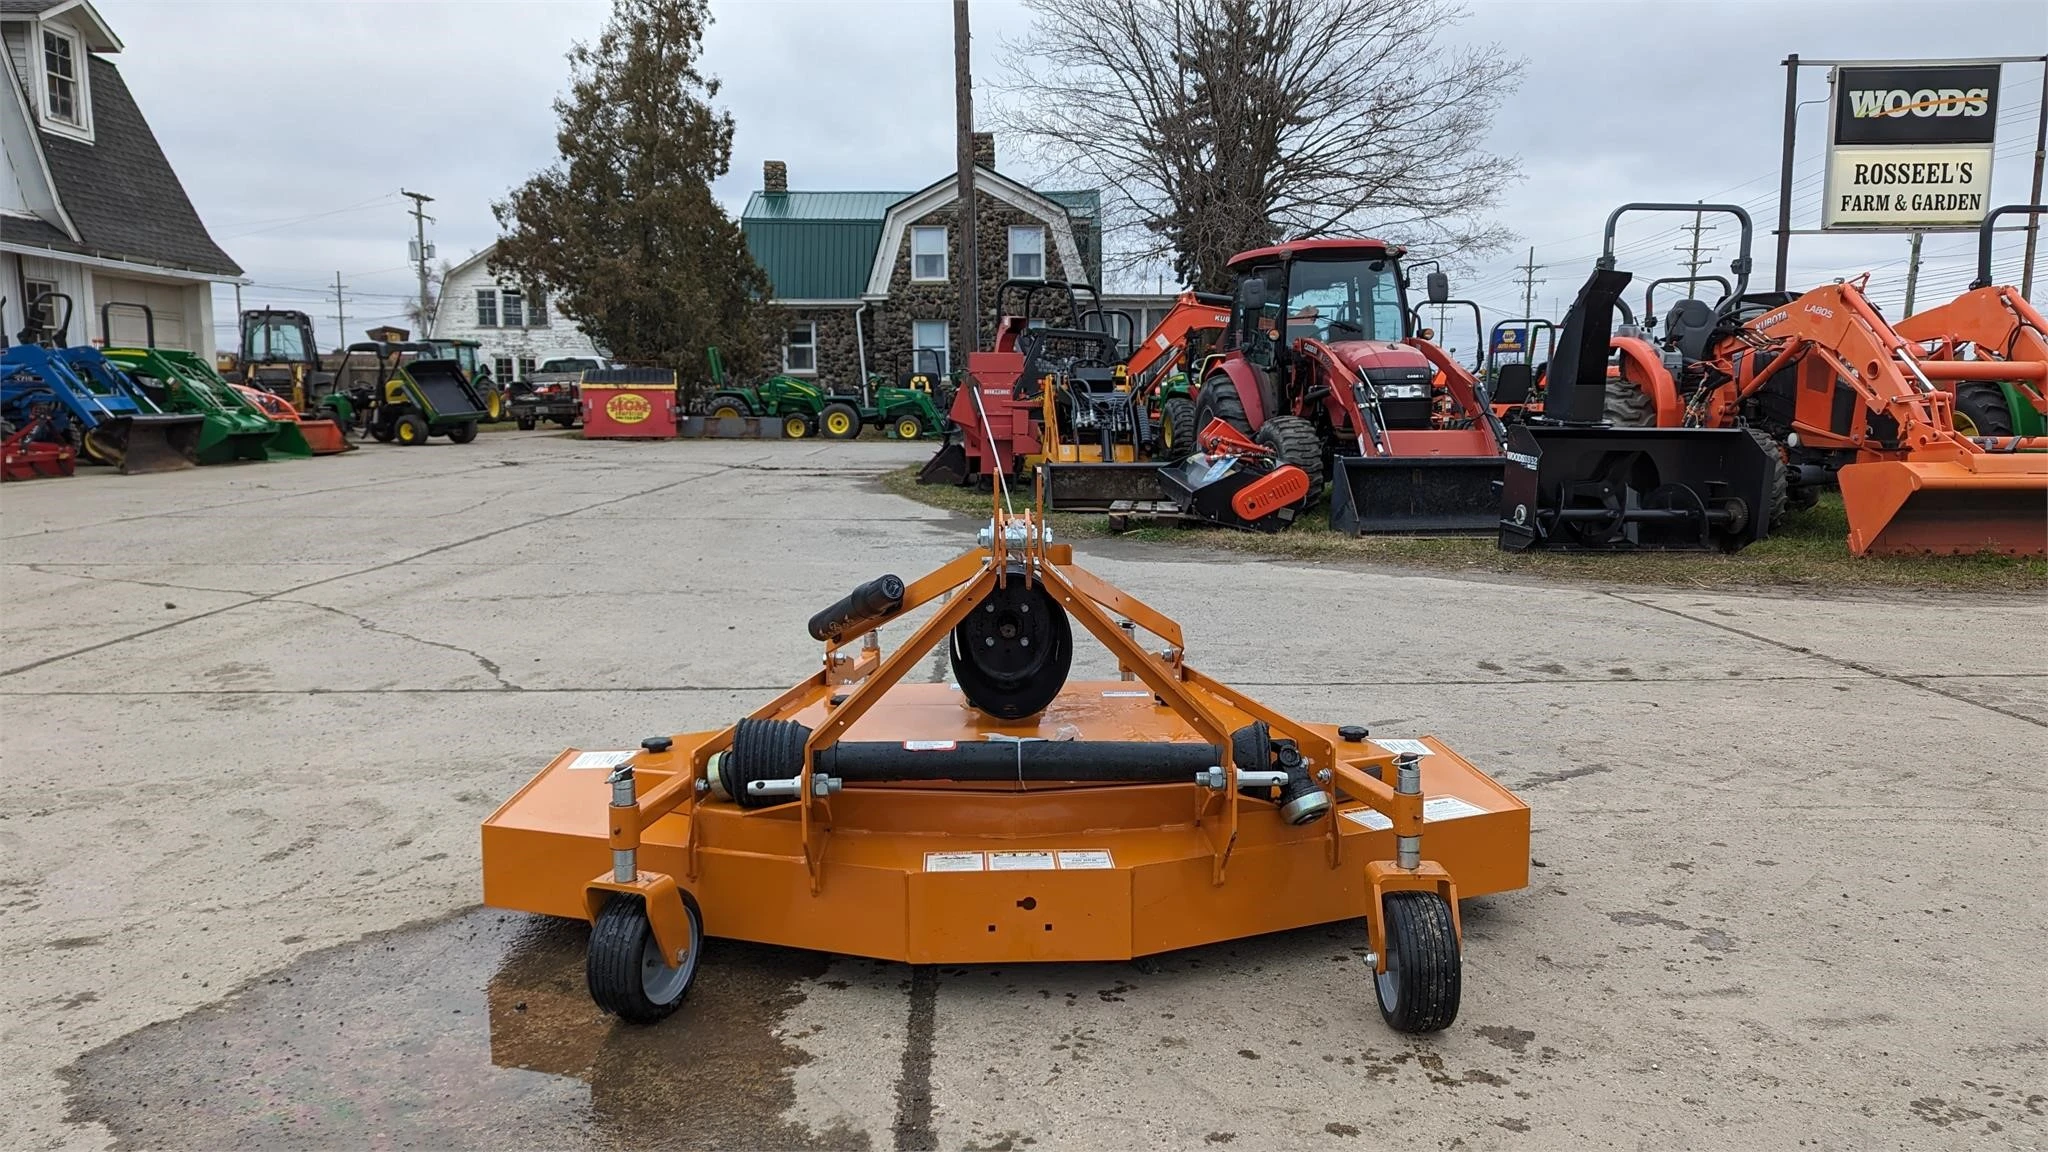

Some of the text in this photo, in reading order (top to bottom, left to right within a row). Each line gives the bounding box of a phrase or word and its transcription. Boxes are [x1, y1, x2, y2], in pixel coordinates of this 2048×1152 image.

[1849, 88, 1989, 118] WOODS
[1853, 162, 1973, 185] ROSSEEL'S
[1840, 193, 1982, 212] FARM & GARDEN
[1755, 310, 1788, 330] KUBOTA
[1804, 303, 1834, 319] LA805
